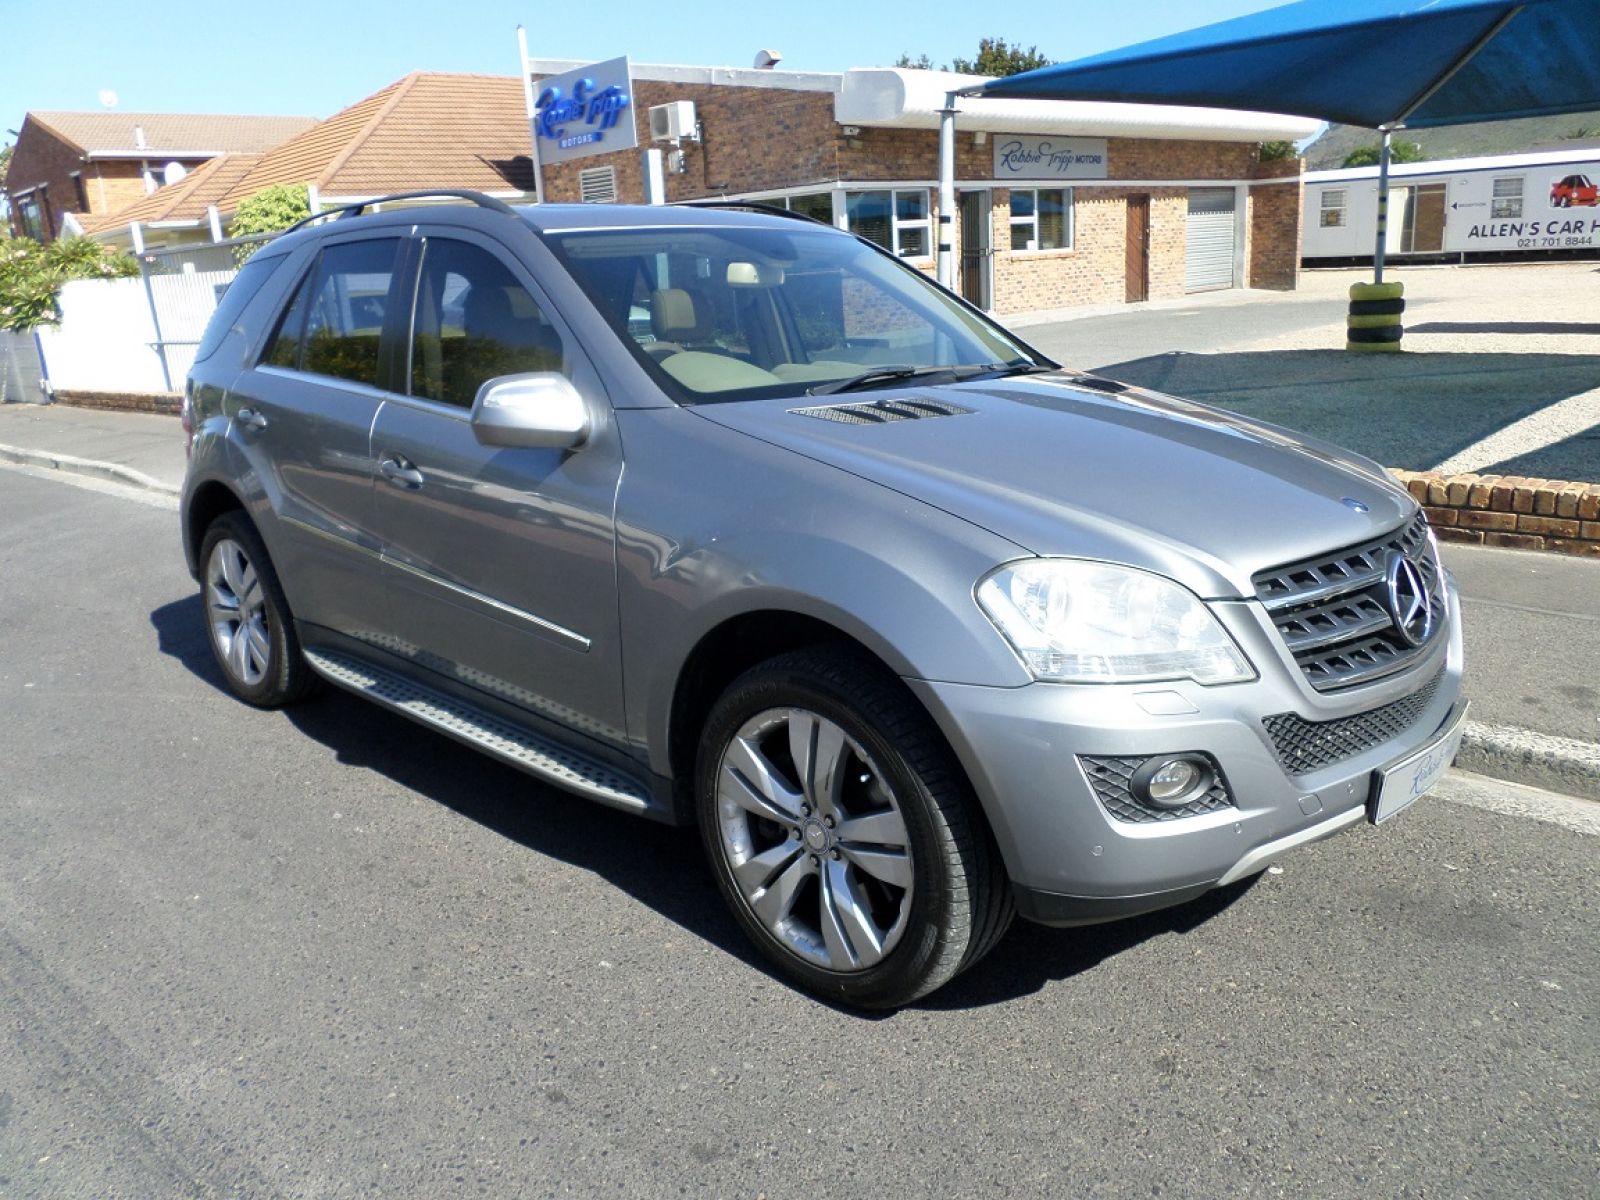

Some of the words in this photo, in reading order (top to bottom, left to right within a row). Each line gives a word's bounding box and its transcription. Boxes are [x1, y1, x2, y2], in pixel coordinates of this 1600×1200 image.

[560, 134, 594, 148] MOTORS
[1000, 141, 1041, 171] Robbie
[1038, 141, 1074, 172] Tripp
[1075, 154, 1102, 165] MOTORS
[1468, 221, 1540, 239] ALLEN'S
[1546, 220, 1585, 235] CAR
[1517, 238, 1537, 248] 021
[1541, 237, 1561, 247] 701
[1564, 236, 1593, 246] 8844
